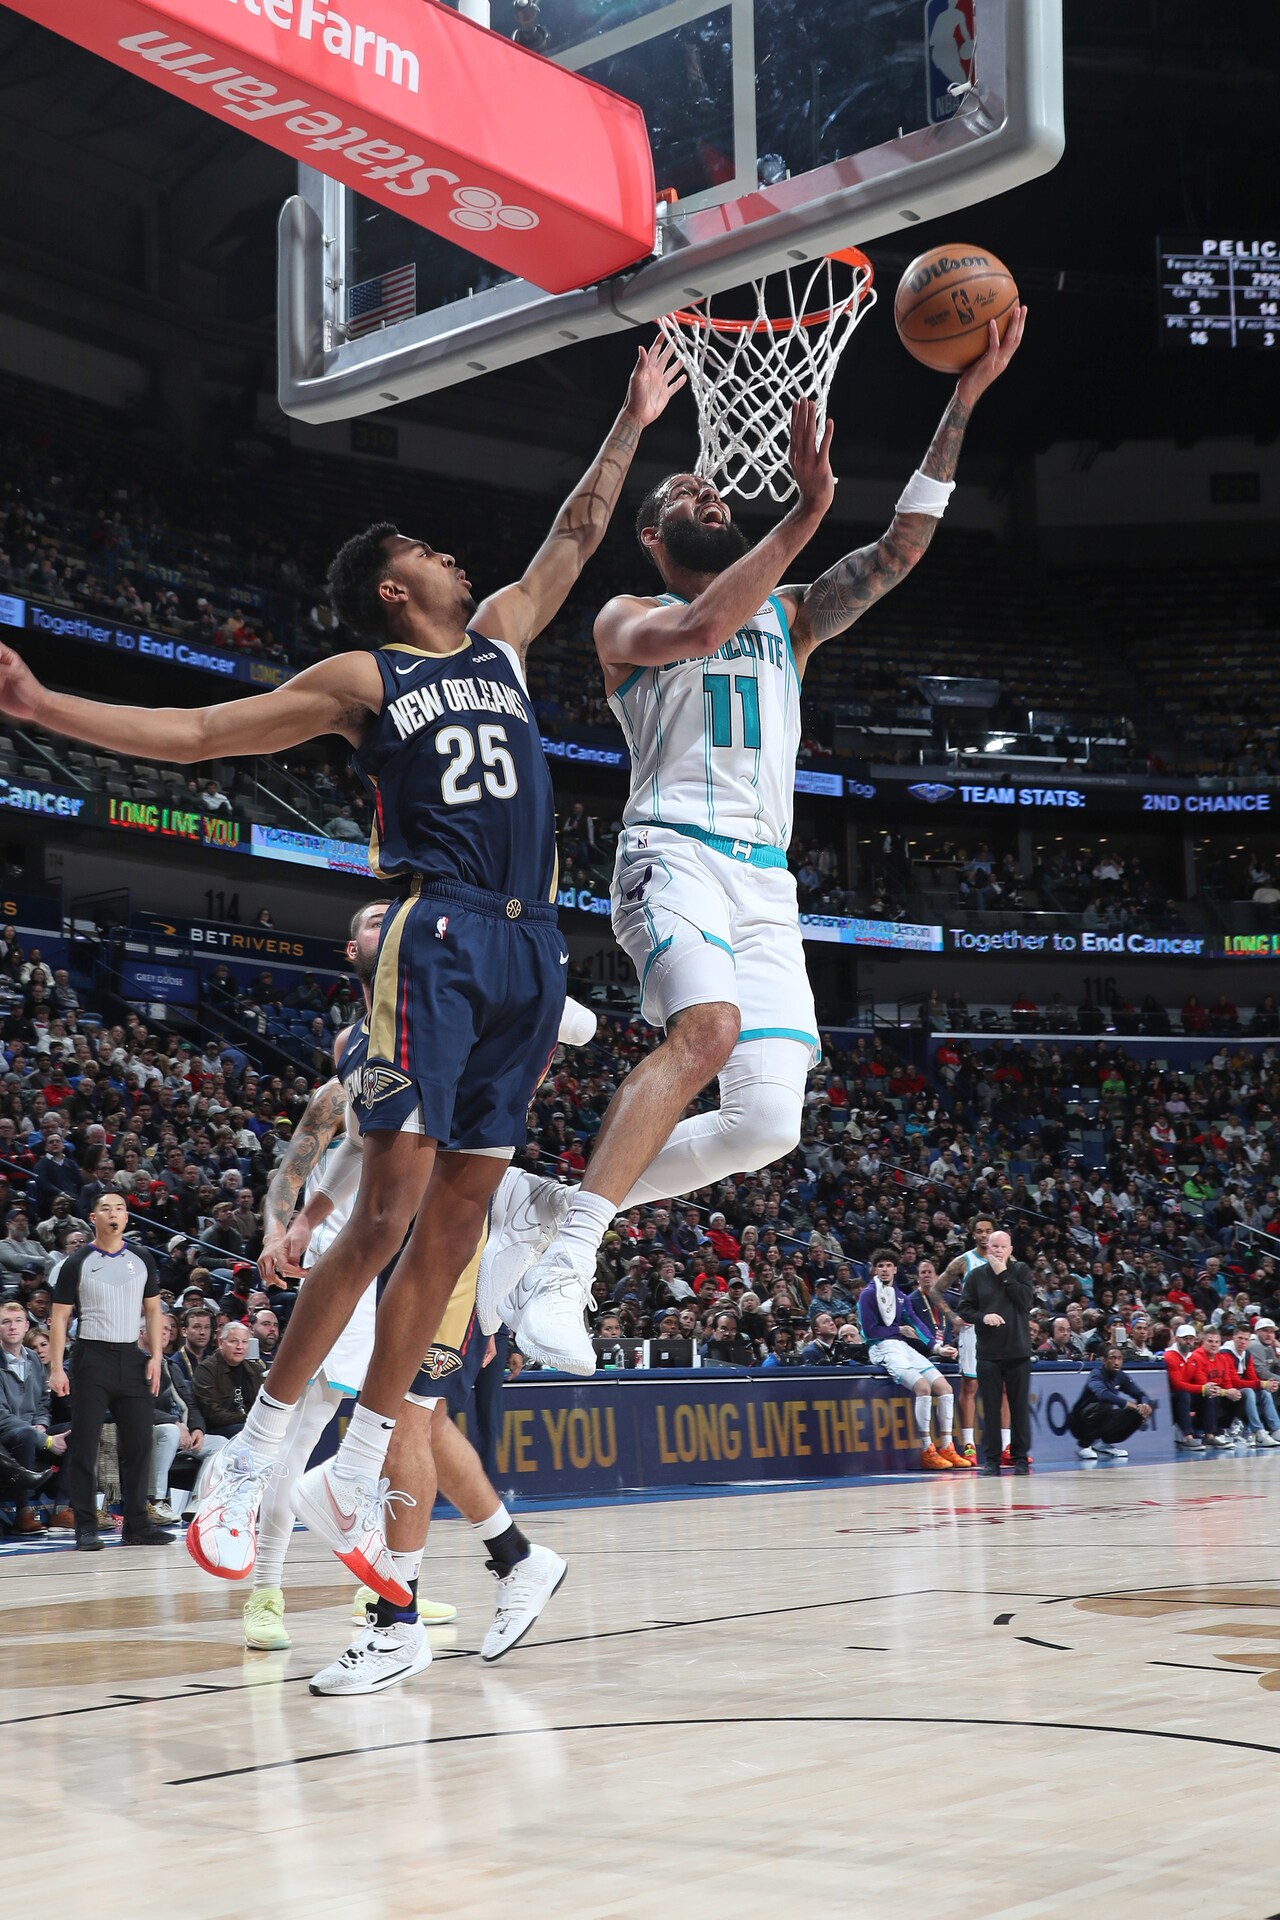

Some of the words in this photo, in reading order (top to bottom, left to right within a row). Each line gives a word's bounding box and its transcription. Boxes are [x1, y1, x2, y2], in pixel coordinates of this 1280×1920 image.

[1202, 239, 1280, 258] PELIC
[909, 255, 990, 294] Wilson
[1181, 271, 1216, 286] 62%
[30, 607, 112, 644] Together
[116, 629, 136, 649] to
[138, 635, 175, 660] End
[175, 645, 236, 674] Cancer
[664, 628, 783, 671] LOTTE
[386, 682, 446, 741] NEW
[441, 676, 530, 724] ORLEANS
[702, 673, 762, 750] 11
[434, 723, 519, 805] 25
[540, 736, 566, 757] End
[565, 742, 623, 764] Cancer
[959, 785, 1015, 804] TEAM
[1019, 788, 1086, 807] STATS:
[1142, 794, 1180, 811] 2ND
[1185, 794, 1271, 812] CHANCE
[109, 798, 160, 833] LONG
[160, 807, 201, 840] LIVE
[203, 815, 240, 848] YOU
[204, 888, 240, 923] 114
[577, 889, 612, 916] Can
[189, 927, 305, 957] BETRIVERS
[949, 928, 1048, 953] Together
[1053, 932, 1077, 951] to
[1081, 932, 1126, 952] End
[1127, 933, 1204, 955] Cancer
[1224, 935, 1270, 956] LONG
[595, 948, 630, 982] 115
[541, 1406, 617, 1471] YOU
[656, 1402, 742, 1463] LONG
[746, 1400, 812, 1459] LIVE
[813, 1398, 870, 1455] THE
